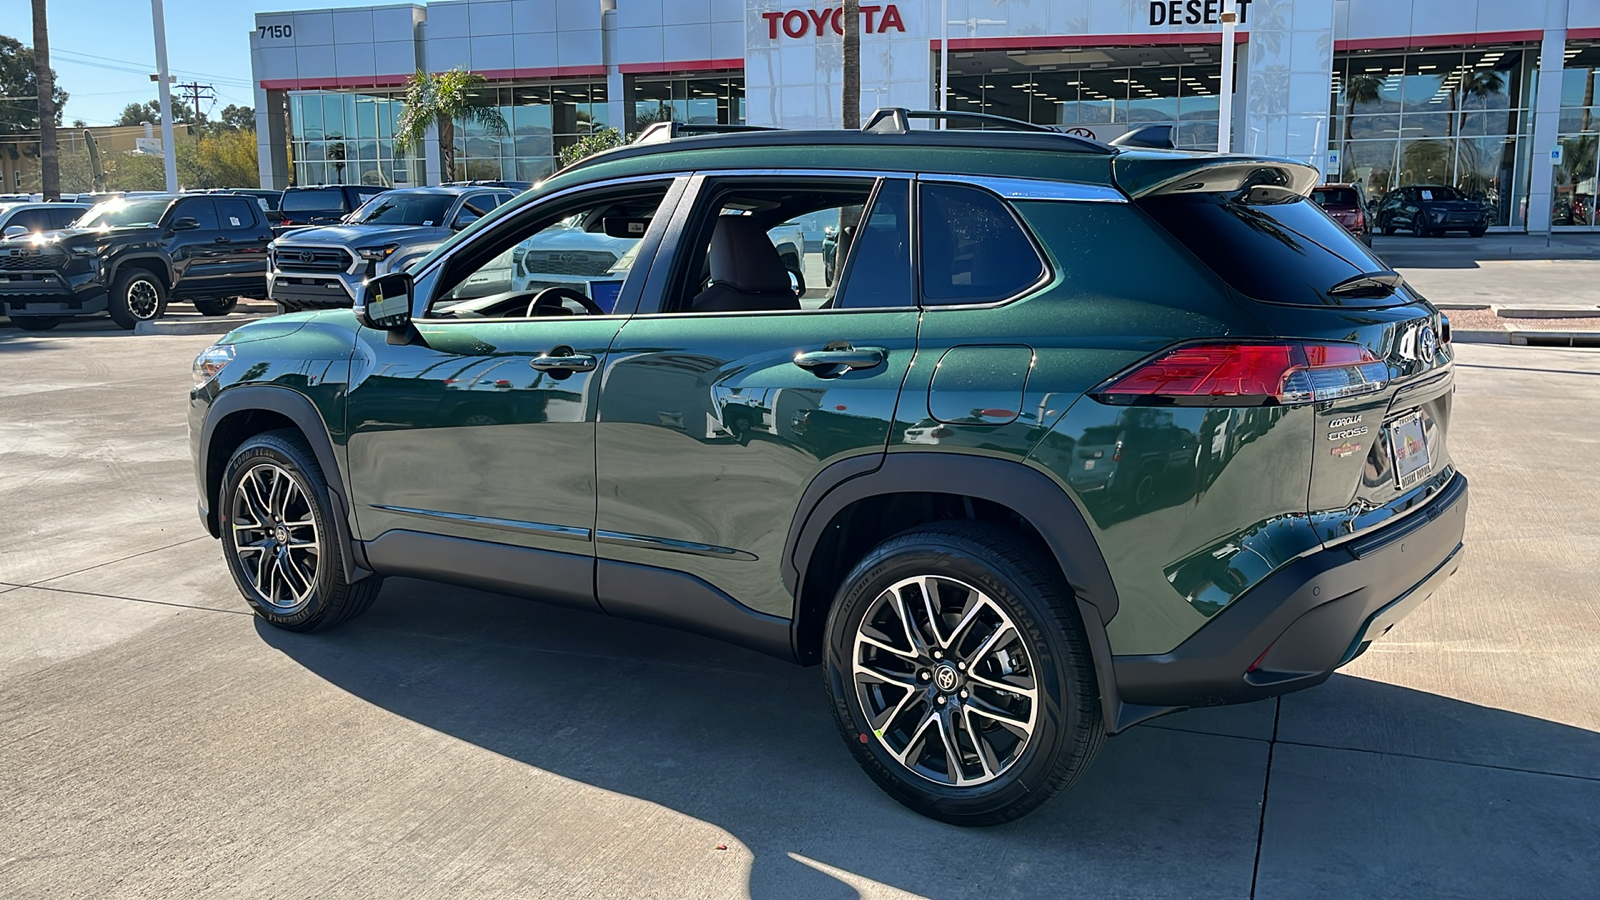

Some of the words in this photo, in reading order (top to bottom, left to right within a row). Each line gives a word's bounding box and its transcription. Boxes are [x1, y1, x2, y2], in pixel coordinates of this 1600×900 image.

[1150, 0, 1252, 26] DESET
[258, 24, 292, 39] 7150
[1328, 414, 1362, 428] COROLLA
[1328, 426, 1368, 441] CROSS
[980, 573, 1052, 662] ASSURANCE
